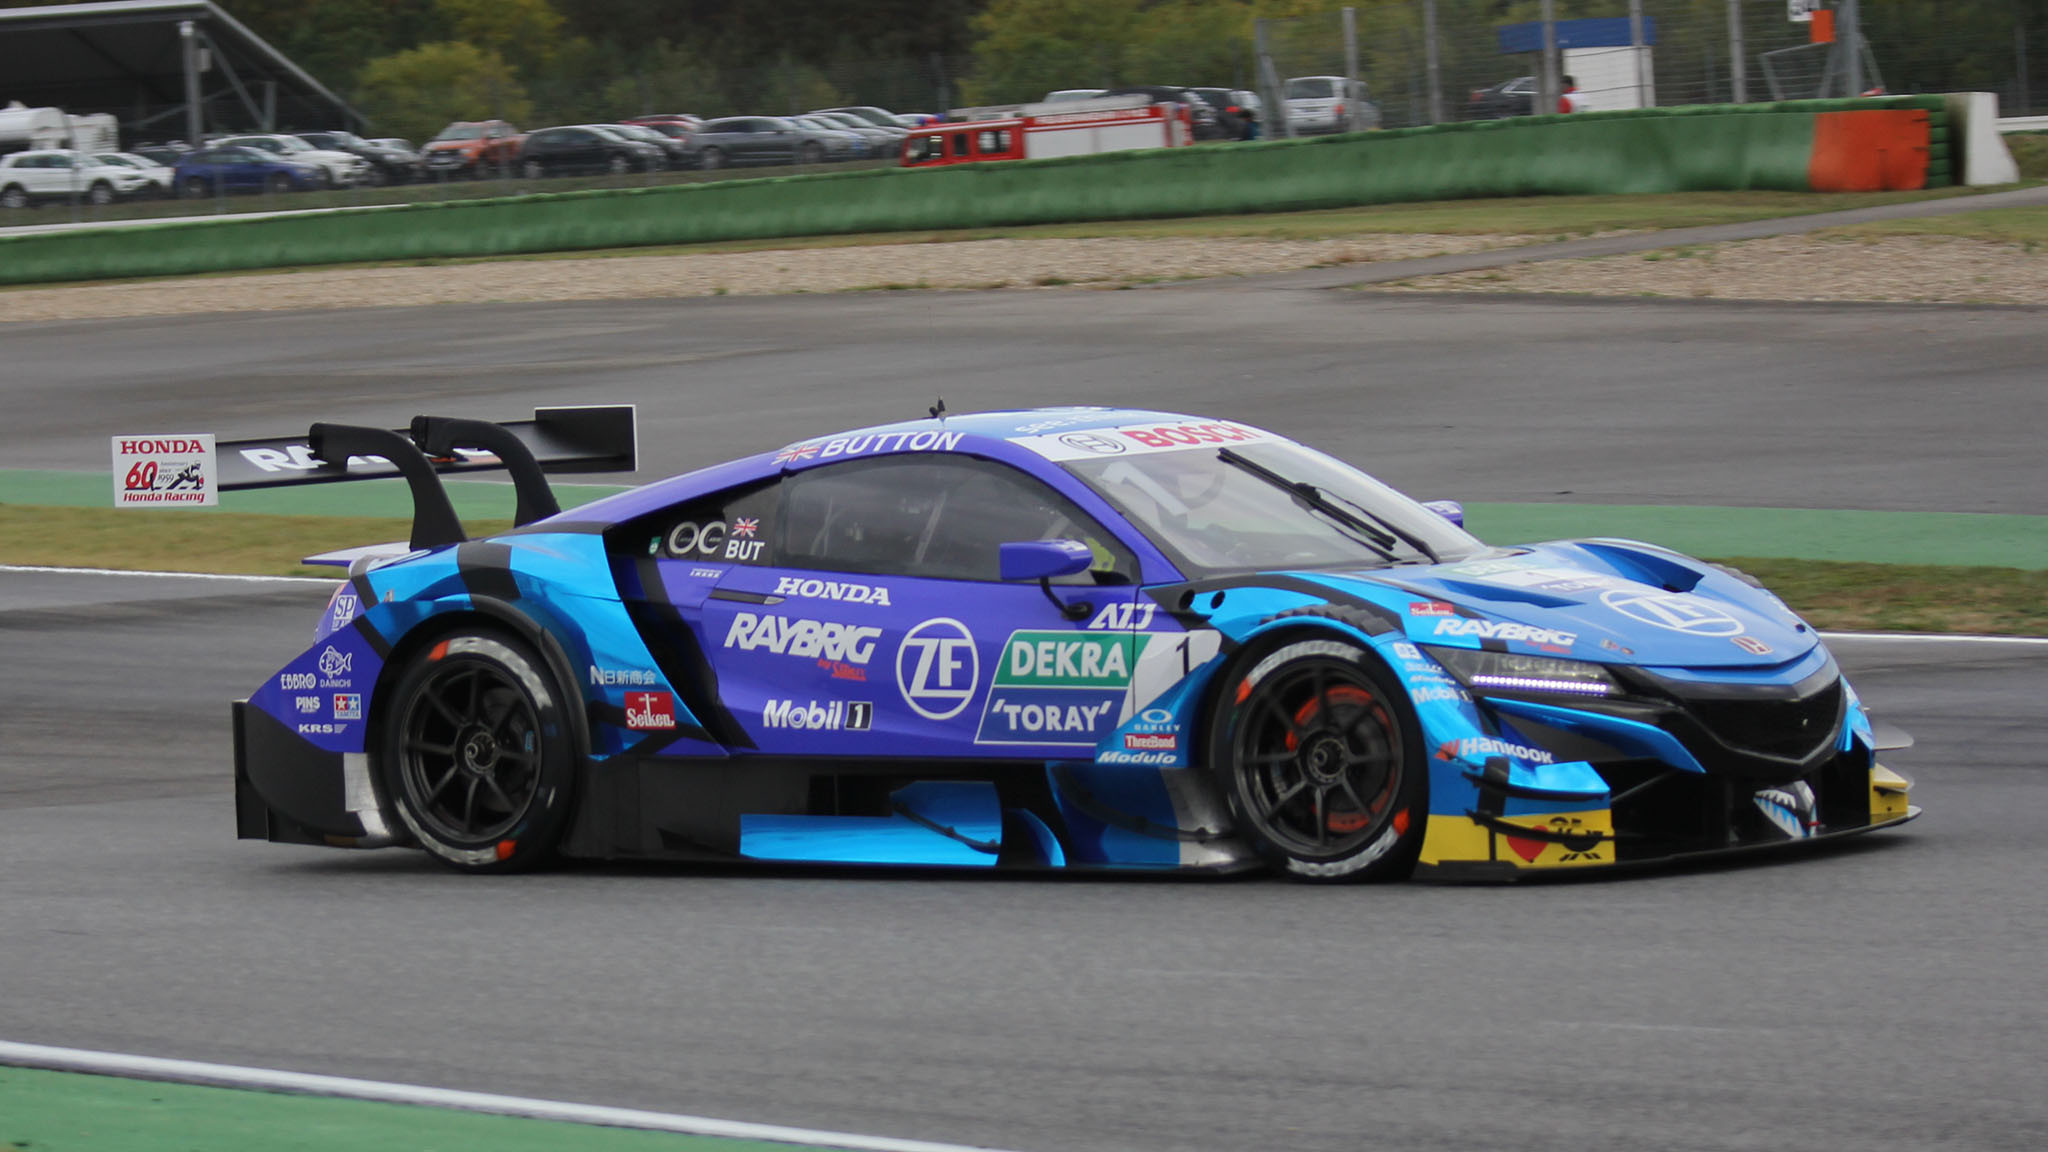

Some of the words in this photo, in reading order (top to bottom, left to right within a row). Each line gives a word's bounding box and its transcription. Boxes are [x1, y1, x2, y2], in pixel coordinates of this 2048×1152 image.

[120, 440, 206, 454] HONDA
[820, 432, 966, 458] BUTTON
[1119, 423, 1262, 448] BOSCH
[125, 461, 158, 489] 60
[123, 493, 163, 502] Honda
[164, 492, 205, 504] Racing
[724, 540, 765, 561] BUT
[774, 576, 891, 606] HONDA
[335, 596, 356, 618] SP
[724, 612, 883, 664] RAYBRIG
[1433, 618, 1580, 647] RAYBRIG
[1011, 641, 1129, 677] DEKRA
[1175, 636, 1190, 676] 1
[280, 672, 317, 689] EBBRO
[319, 679, 352, 688] DAINICHI
[296, 696, 321, 710] PINS
[626, 693, 676, 728] Seiken
[763, 699, 843, 730] Mobil
[298, 723, 334, 733] KRS
[1133, 723, 1182, 732] OAKLEY
[1097, 751, 1178, 764] Modulo
[1461, 737, 1554, 764] Hankook
